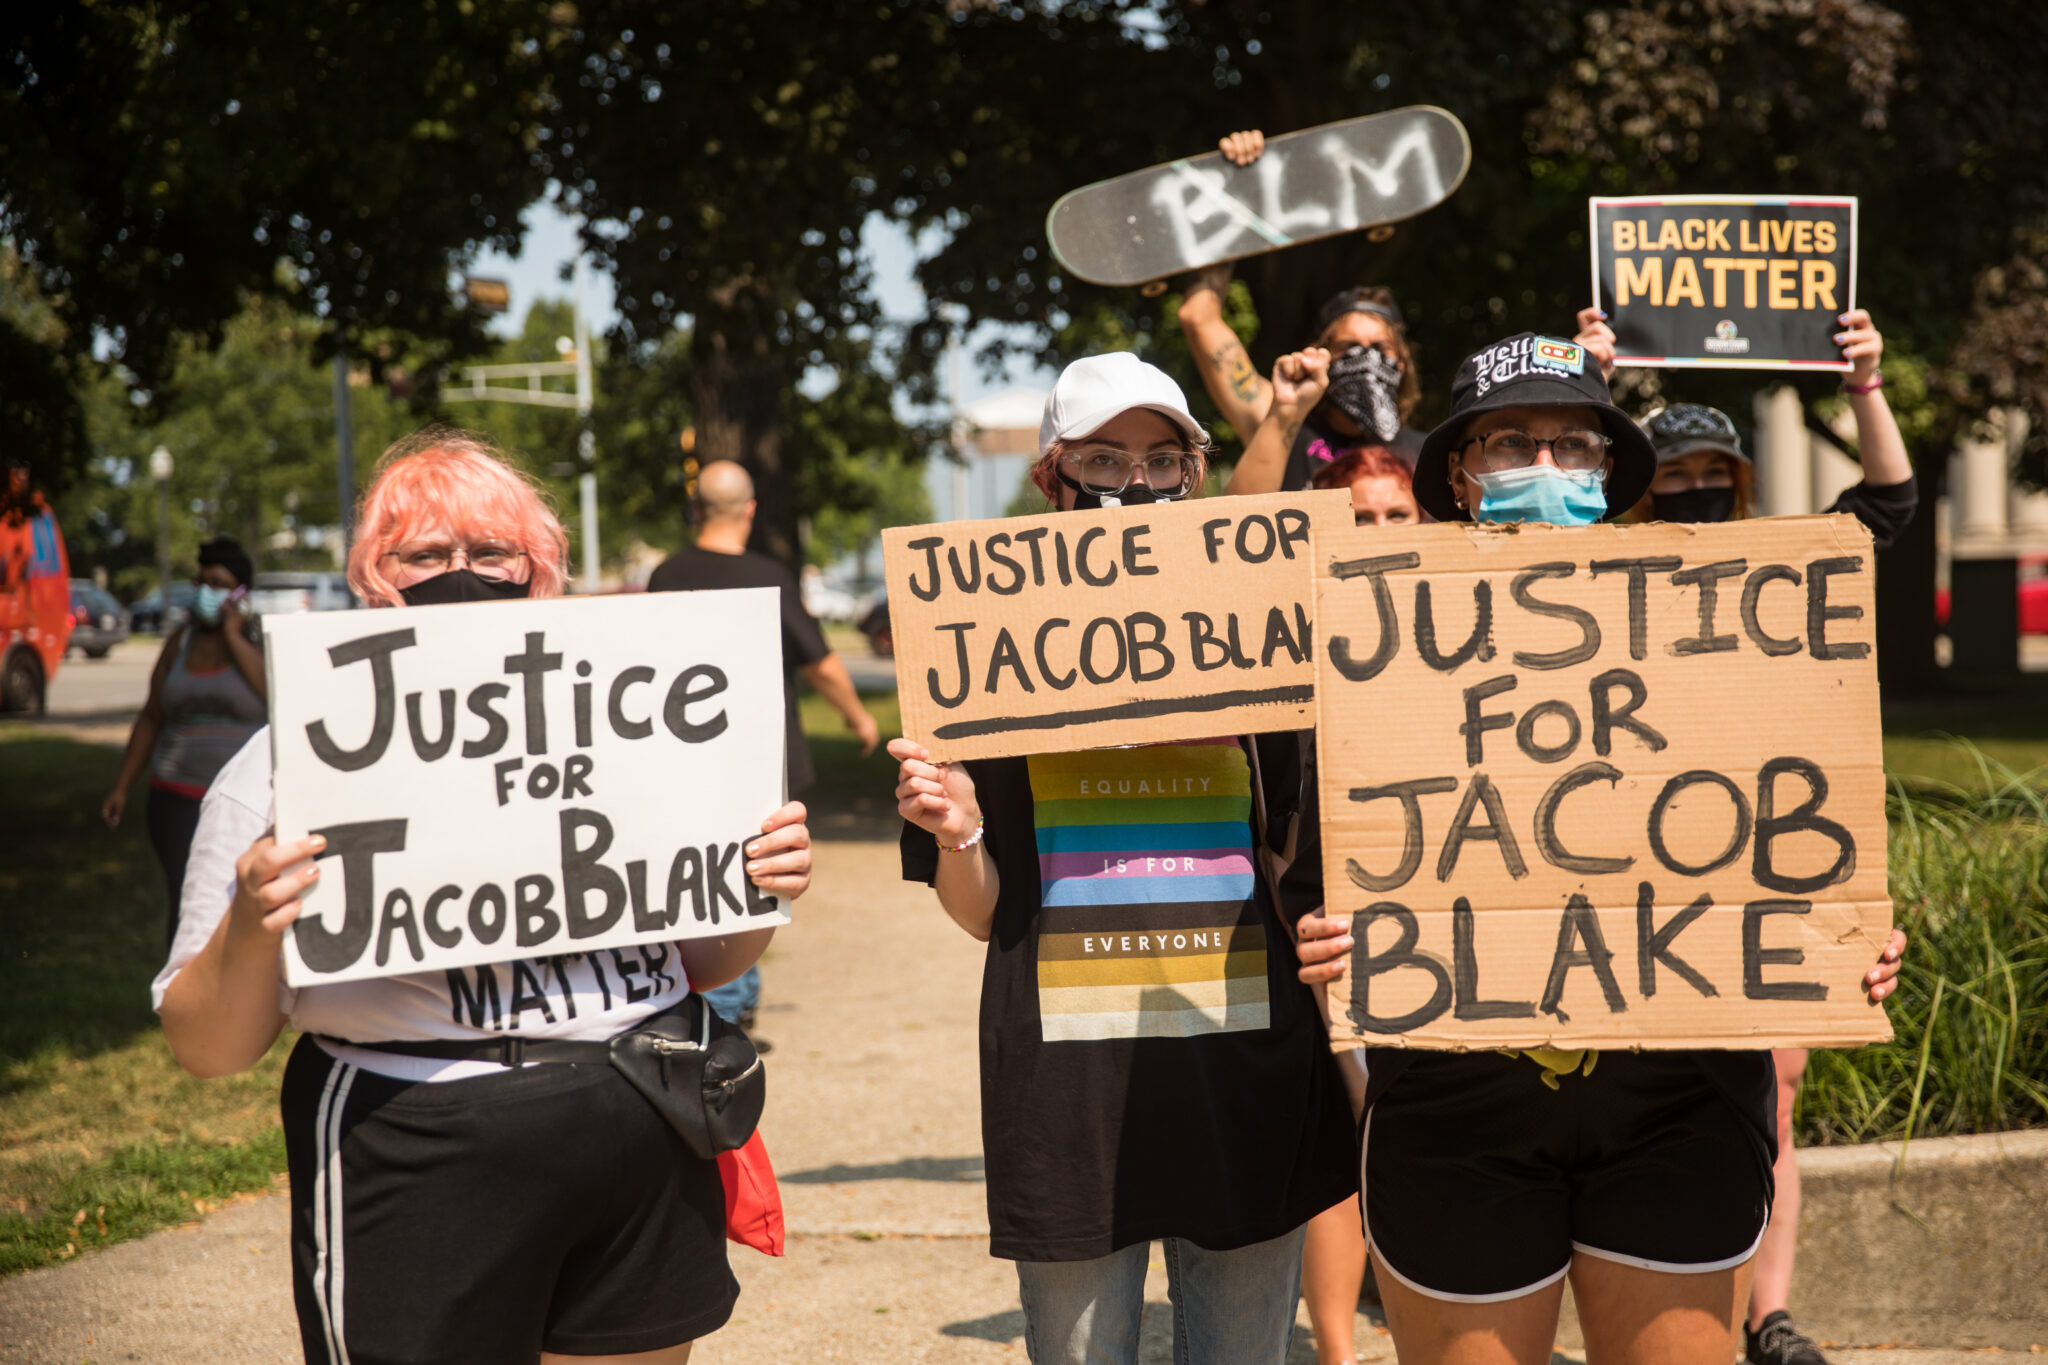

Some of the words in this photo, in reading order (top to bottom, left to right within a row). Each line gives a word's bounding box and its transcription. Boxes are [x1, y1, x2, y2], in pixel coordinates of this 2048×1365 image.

[1152, 119, 1446, 267] BLM
[1612, 219, 1732, 252] BLACK
[1739, 219, 1838, 254] LIVES
[1614, 256, 1838, 311] MATTER
[908, 526, 1160, 602] JUSTICE
[1203, 508, 1310, 564] FOR
[927, 611, 1176, 709] JACOB
[1327, 551, 1872, 682] JUSTICE
[1459, 667, 1669, 768] FOR
[494, 753, 595, 807] FOR
[1079, 777, 1212, 795] EQUALITY
[1344, 756, 1857, 893] JACOB
[292, 817, 561, 974] JACOB
[1103, 858, 1128, 874] IS
[1146, 856, 1196, 873] FOR
[446, 942, 677, 1031] MATTER
[1083, 931, 1222, 953] EVERYONE
[1345, 881, 1830, 1035] BLAKE
